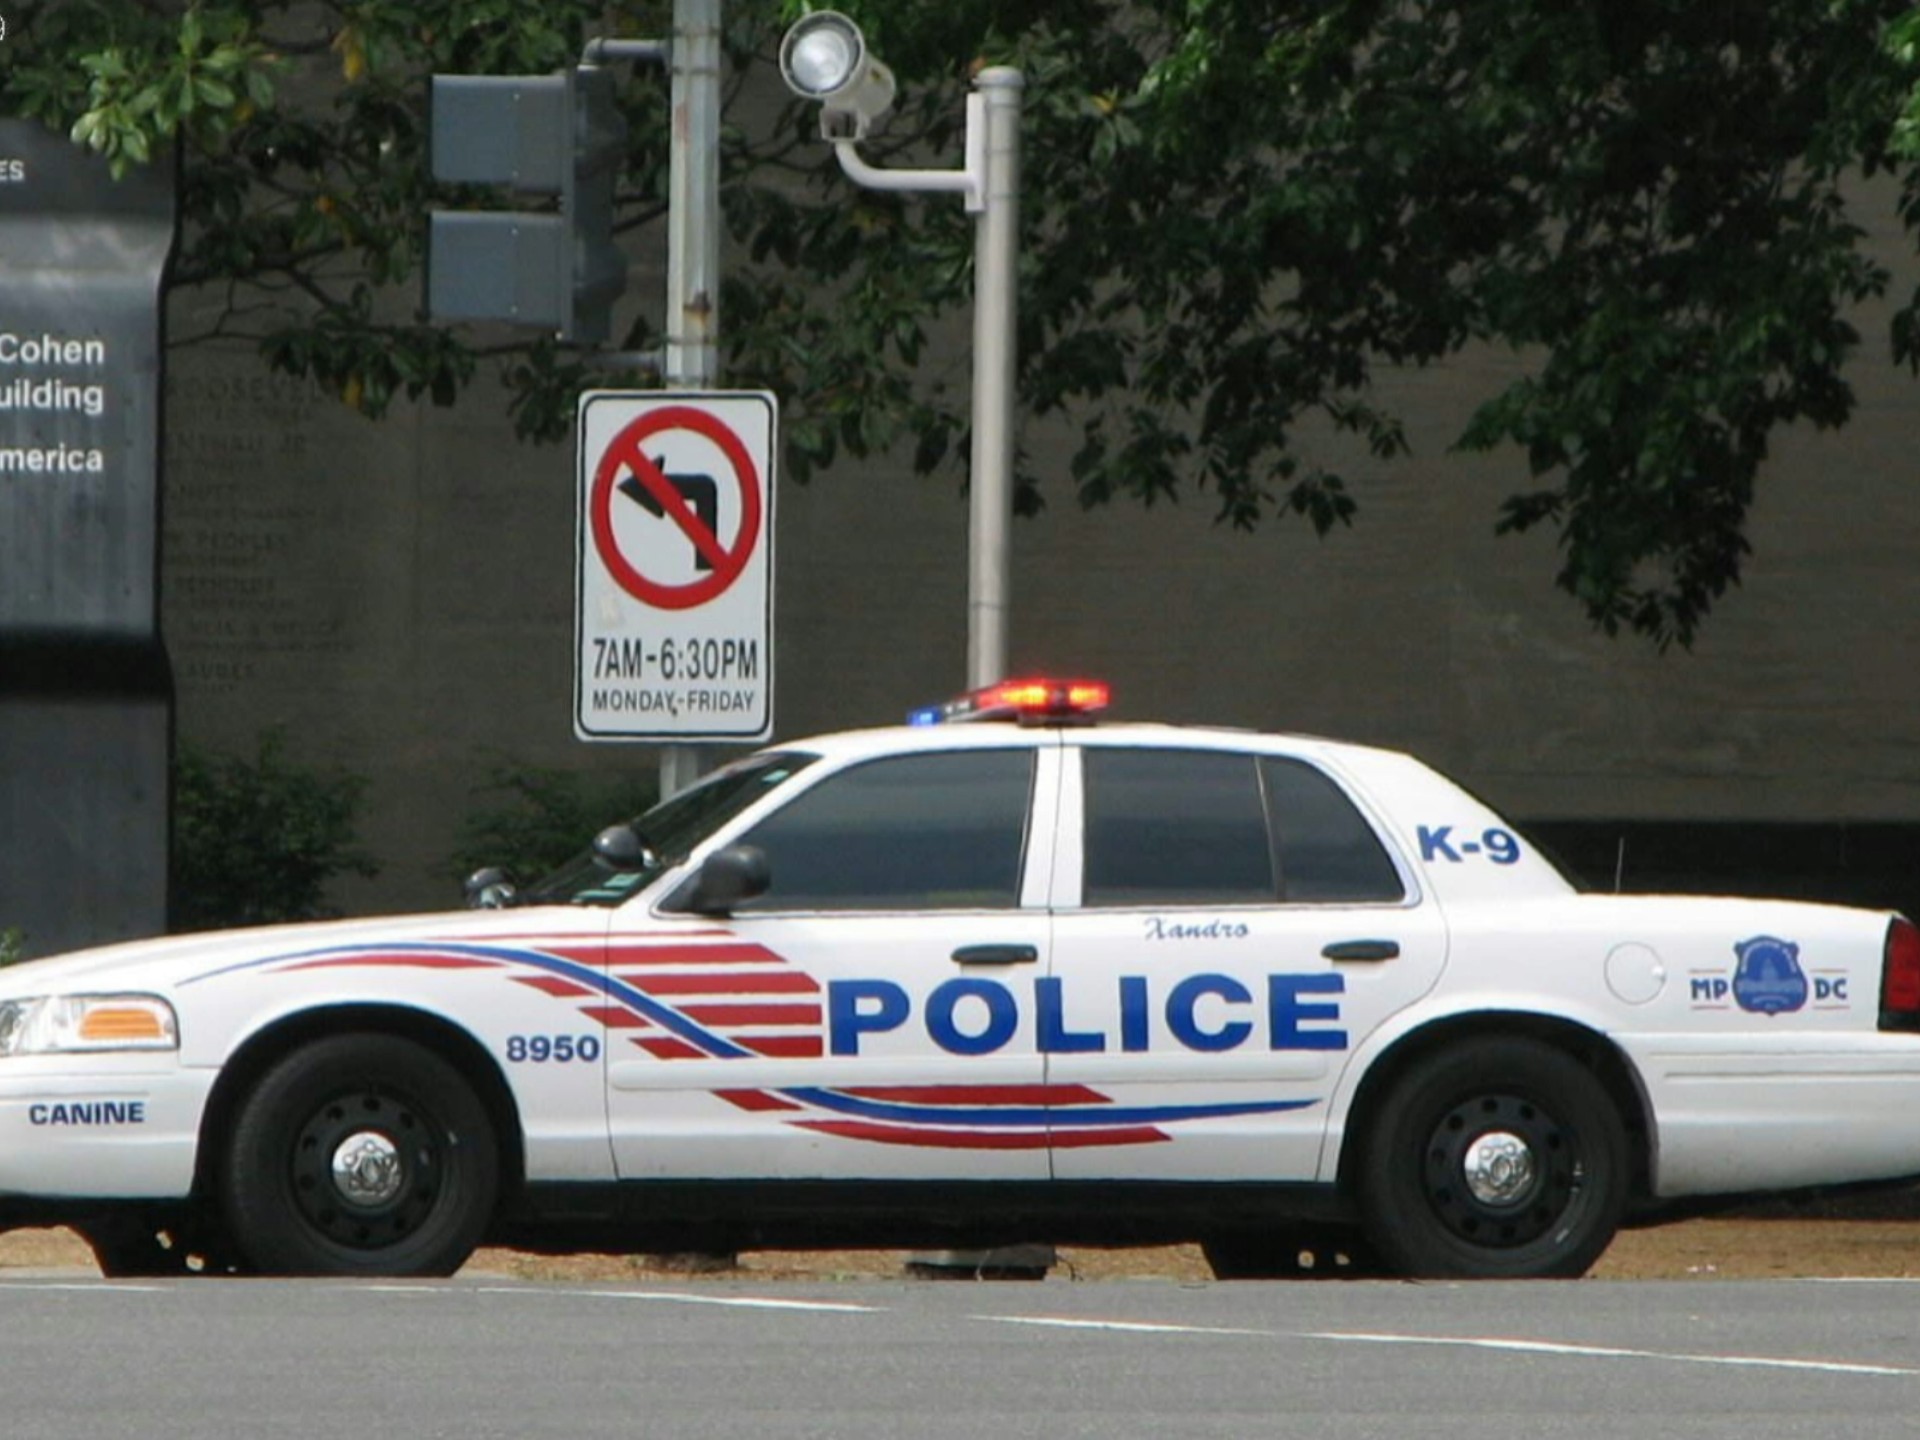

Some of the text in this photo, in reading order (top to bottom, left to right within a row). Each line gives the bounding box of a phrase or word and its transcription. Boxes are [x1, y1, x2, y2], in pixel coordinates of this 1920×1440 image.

[0, 333, 104, 364] Cohen
[0, 441, 103, 472] merica
[593, 637, 758, 680] 7AM-6:30PM
[592, 690, 754, 711] MONDAY-FRIDAY
[1416, 825, 1521, 865] K-9
[1144, 917, 1249, 940] Xandro
[1690, 978, 1847, 999] MP DC
[828, 973, 1348, 1056] POLICE
[506, 1034, 600, 1063] 8950
[29, 1101, 145, 1126] CANINE
